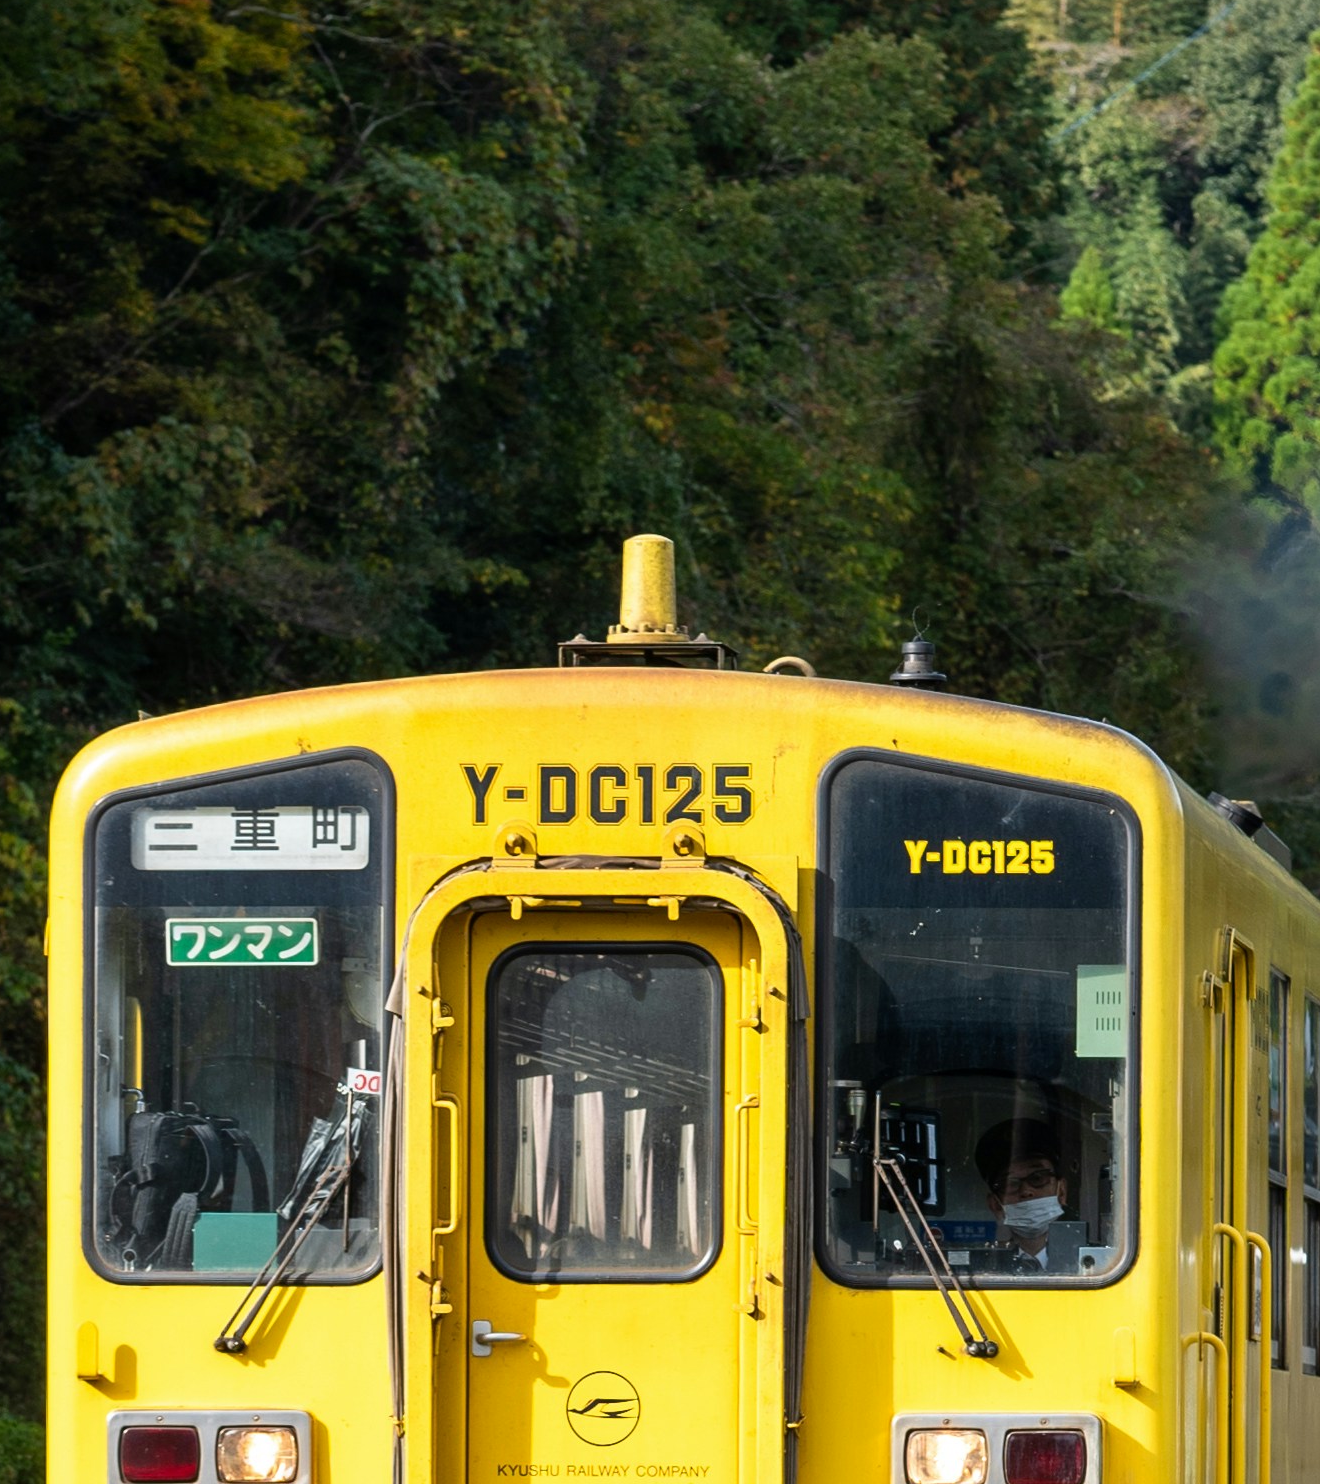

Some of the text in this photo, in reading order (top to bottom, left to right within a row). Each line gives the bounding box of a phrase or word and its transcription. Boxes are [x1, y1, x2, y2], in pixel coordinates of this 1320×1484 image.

[459, 763, 754, 825] Y-DC125
[904, 840, 1055, 874] Y-DC125
[172, 925, 312, 960] ワンマン
[497, 1464, 710, 1478] KYUSHU RAILWAY COMPANY
